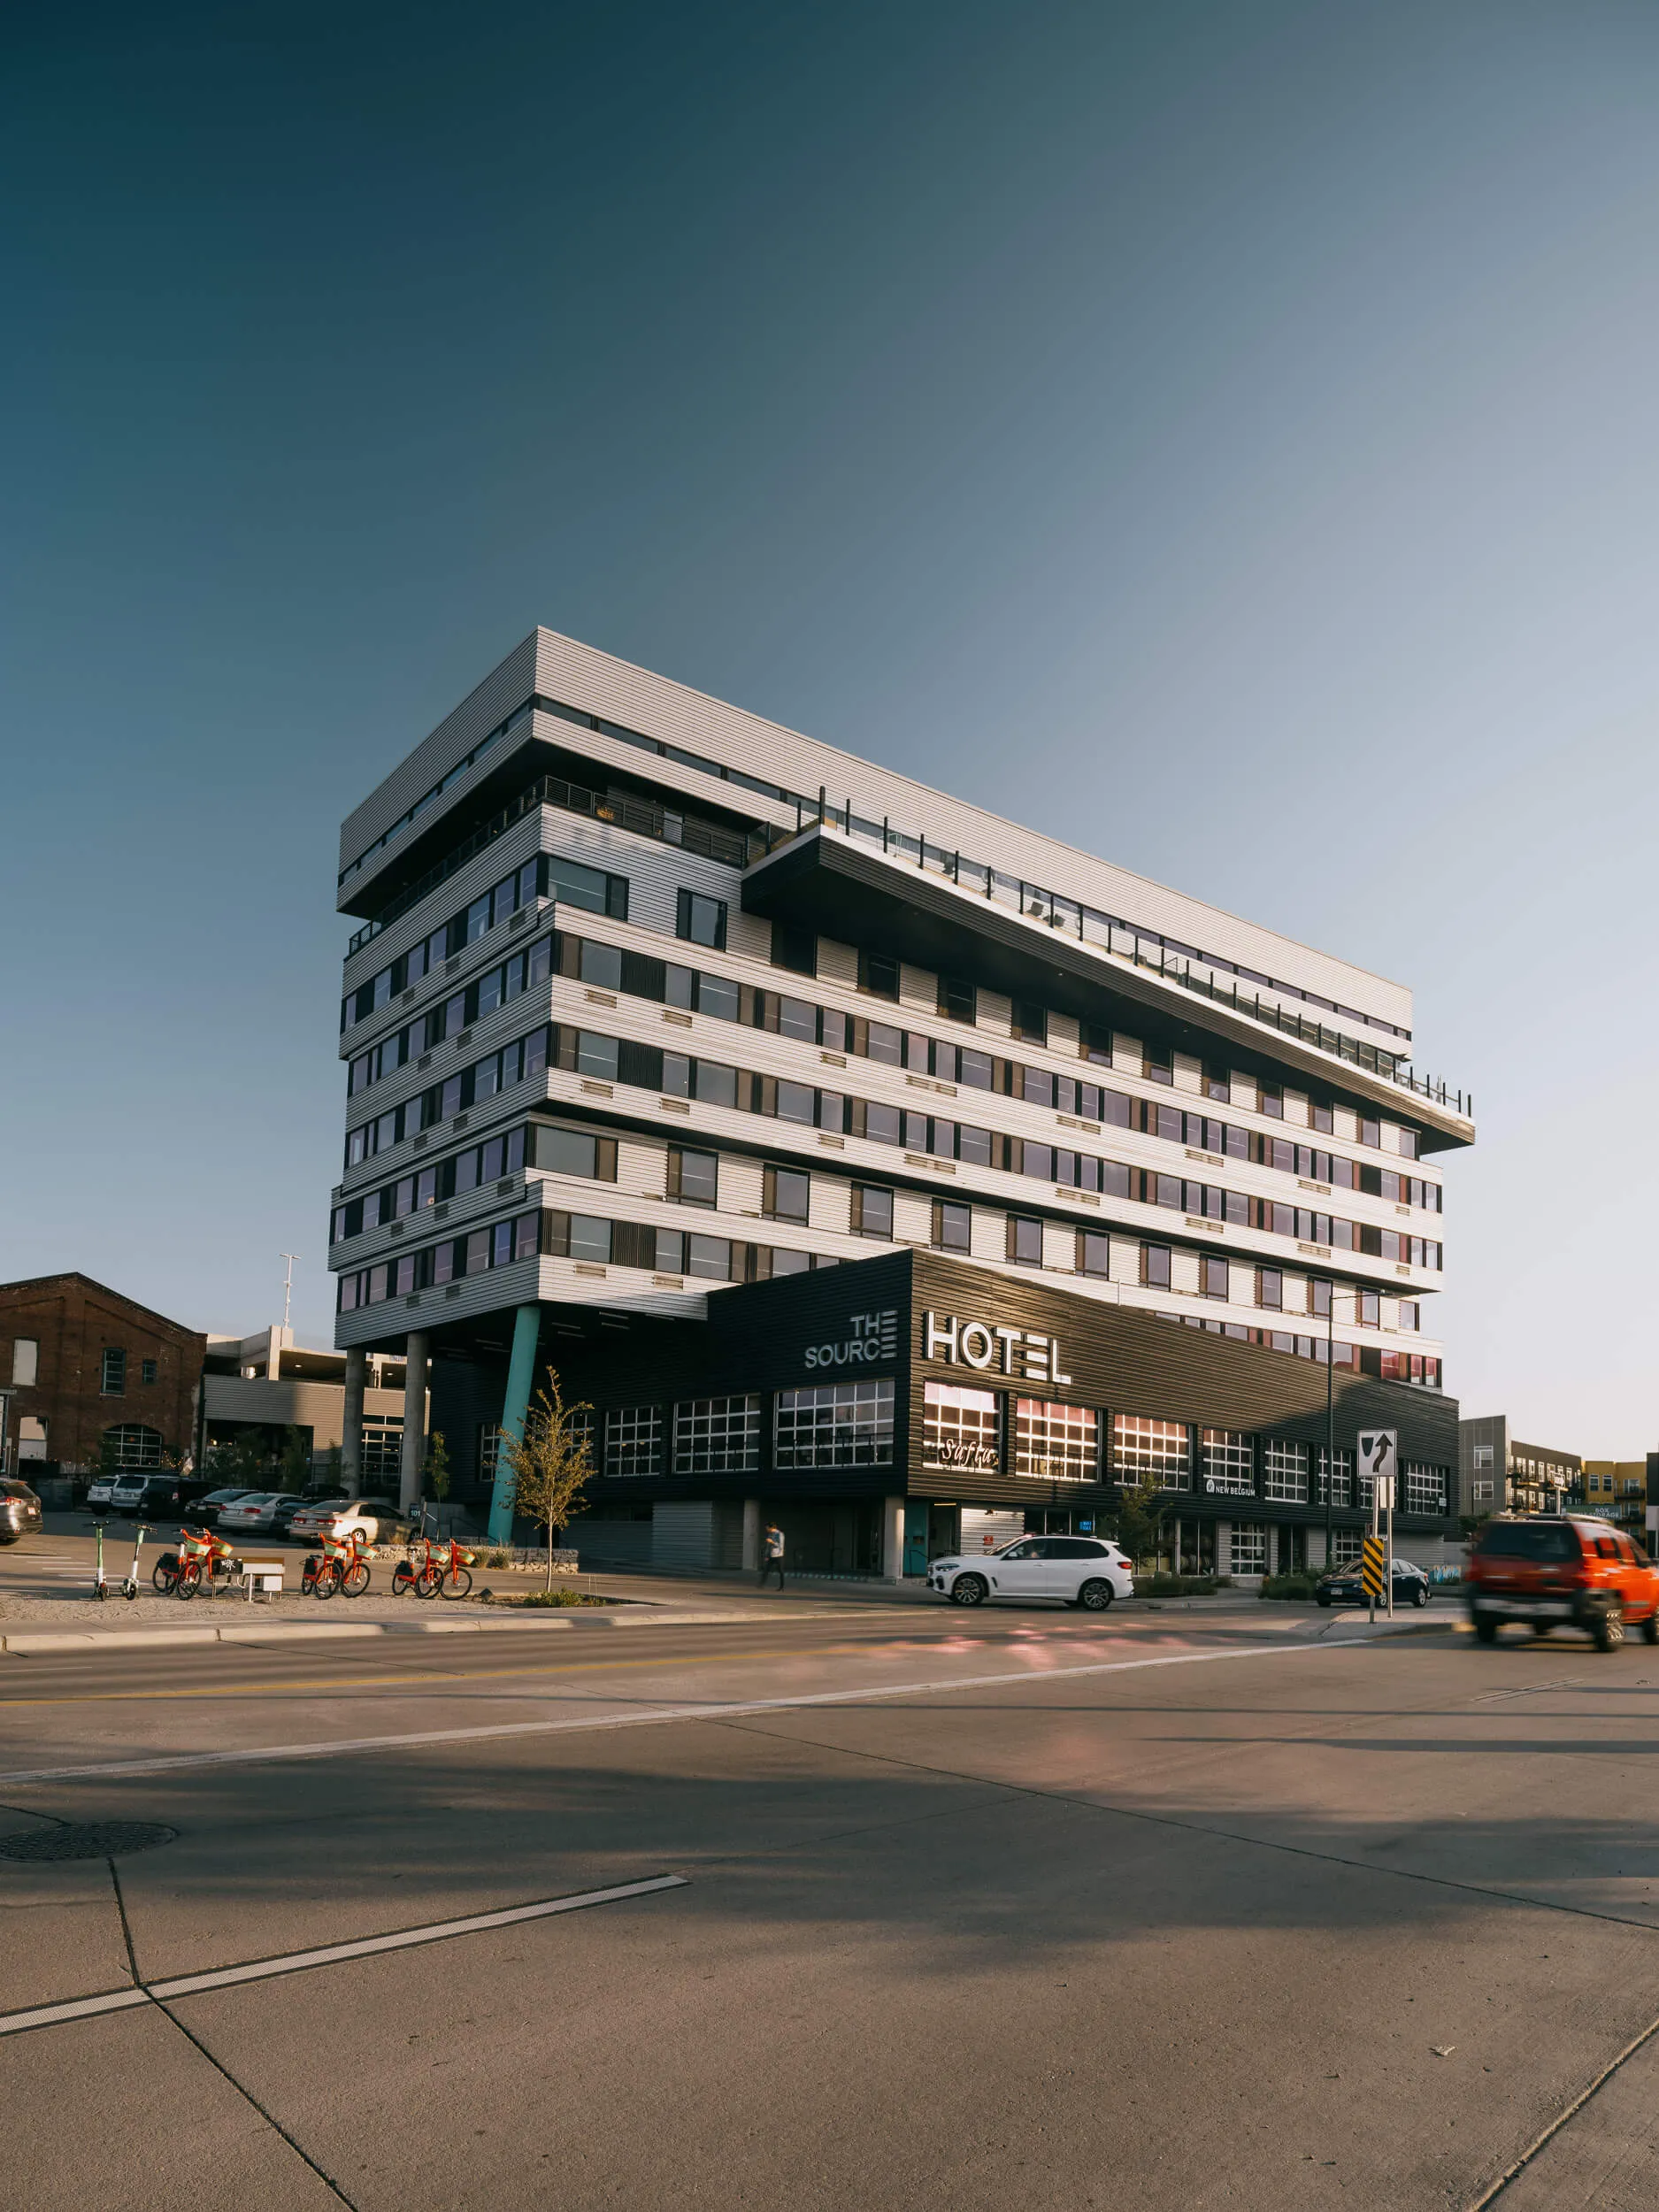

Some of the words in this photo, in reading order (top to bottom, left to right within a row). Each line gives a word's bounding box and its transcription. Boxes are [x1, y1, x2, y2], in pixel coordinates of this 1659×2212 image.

[849, 1310, 898, 1337] THE
[805, 1337, 897, 1369] SOURCE
[924, 1310, 1072, 1385] HOTEL
[941, 1439, 992, 1467] Safta
[1231, 1487, 1256, 1496] BELGIUM
